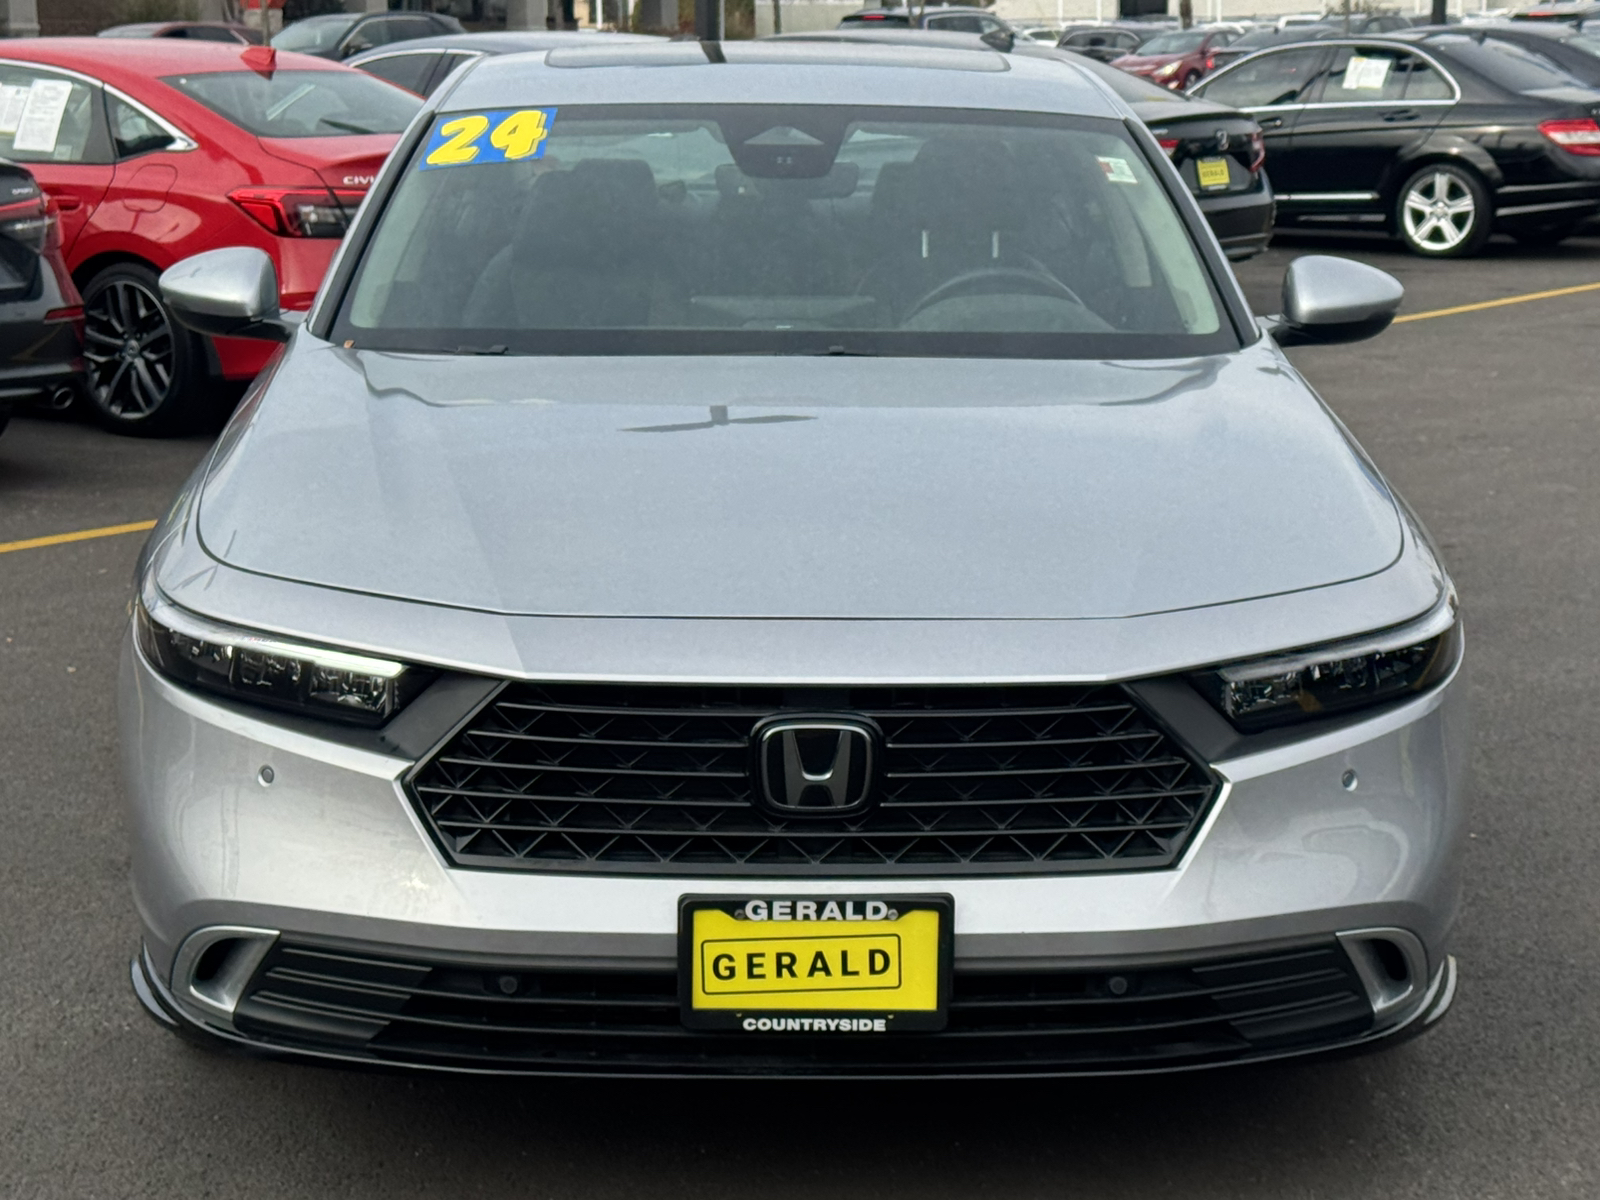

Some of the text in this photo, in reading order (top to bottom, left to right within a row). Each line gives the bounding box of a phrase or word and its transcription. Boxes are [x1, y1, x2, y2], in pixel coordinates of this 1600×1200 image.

[426, 110, 548, 165] 24
[744, 900, 889, 921] GERALD
[711, 948, 891, 981] GERALD
[742, 1018, 887, 1032] COUNTRYSIDE
